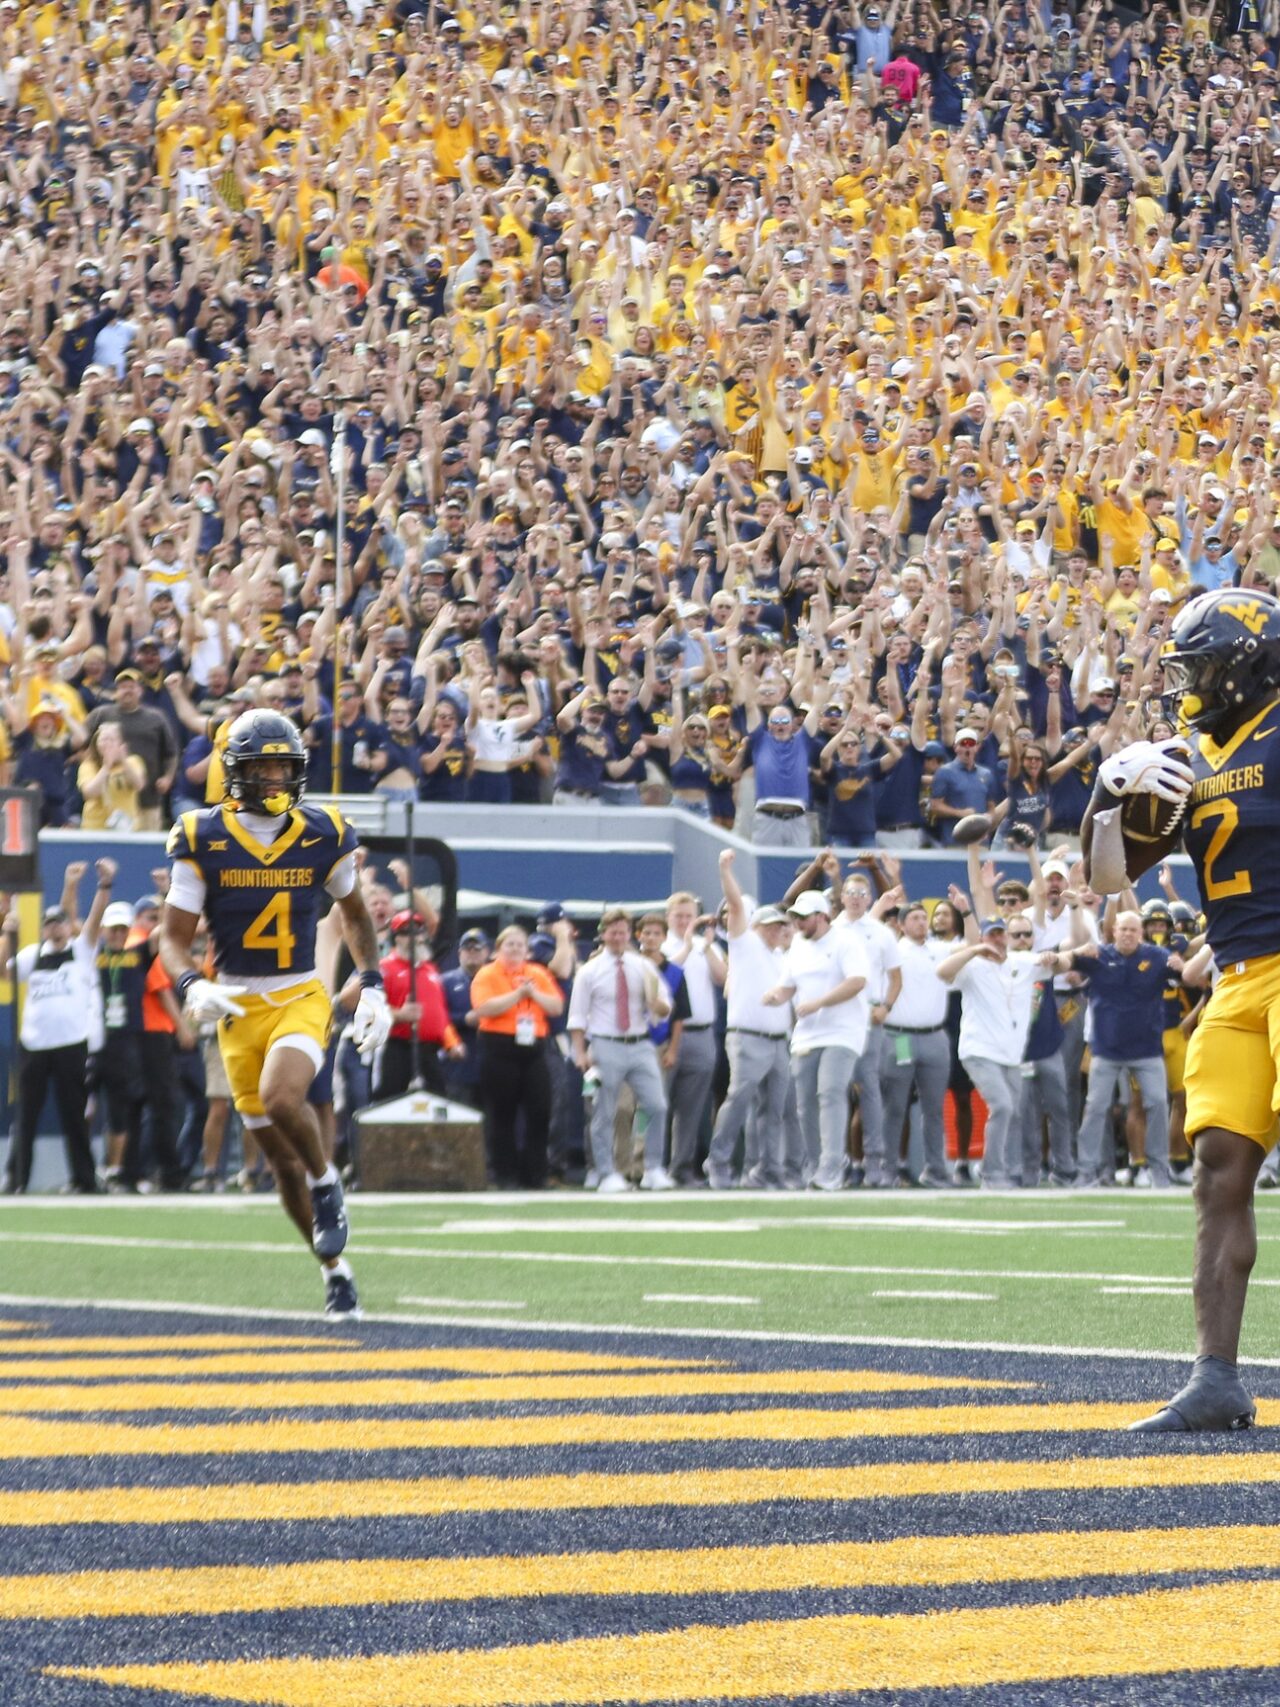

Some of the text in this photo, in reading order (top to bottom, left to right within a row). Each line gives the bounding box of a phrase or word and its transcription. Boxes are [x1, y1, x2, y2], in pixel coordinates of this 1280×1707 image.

[1, 798, 26, 857] 1
[1191, 797, 1252, 901] 2
[219, 867, 315, 888] MOUNTAINEERS
[242, 891, 297, 970] 4
